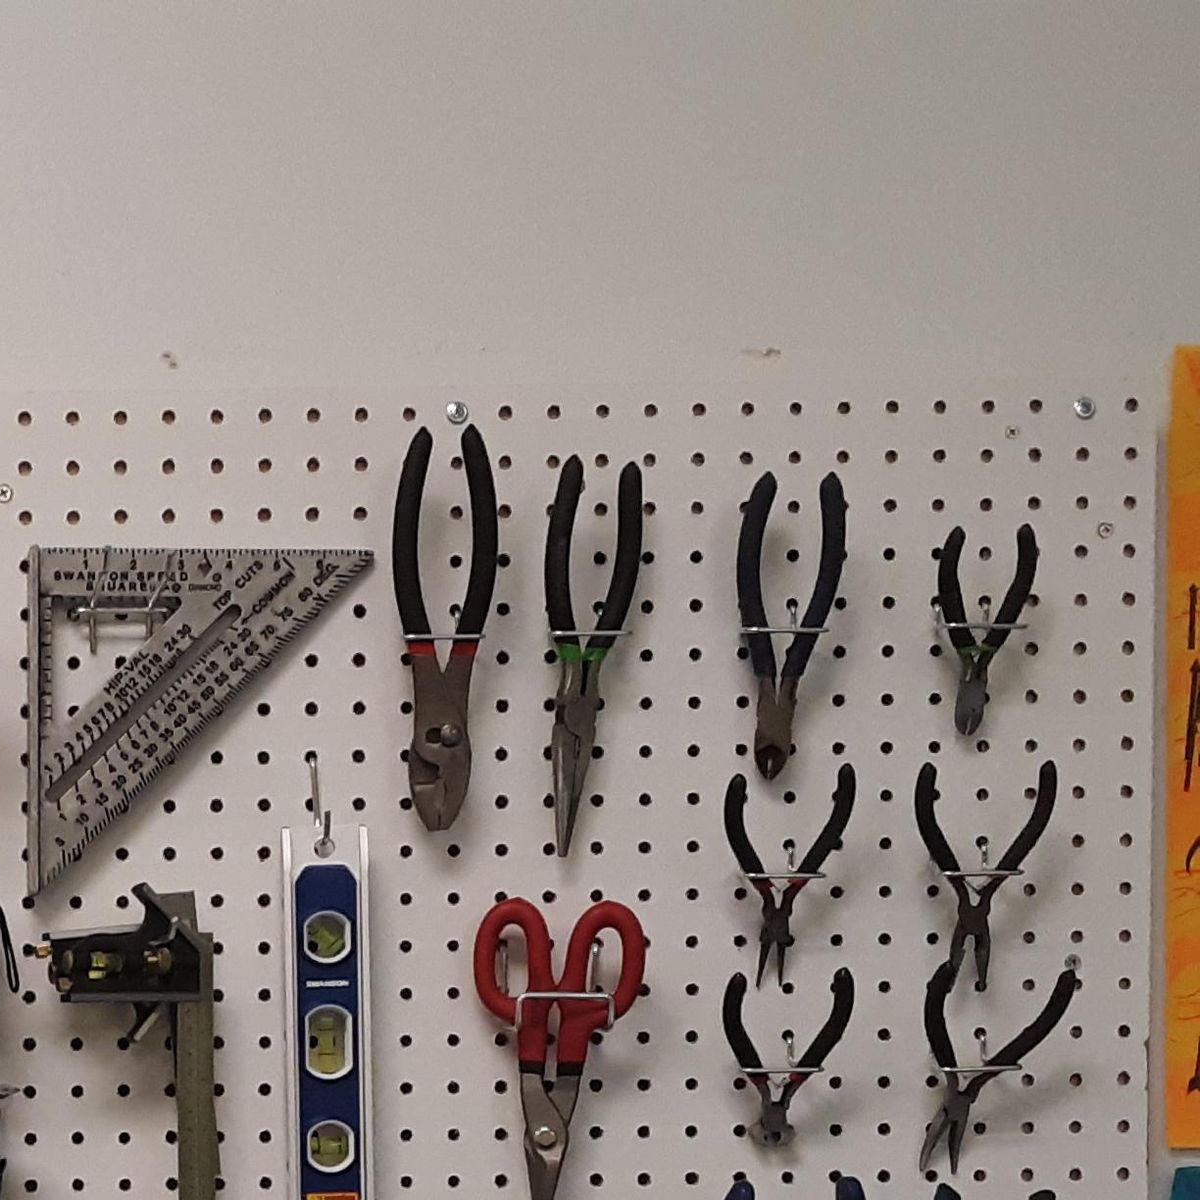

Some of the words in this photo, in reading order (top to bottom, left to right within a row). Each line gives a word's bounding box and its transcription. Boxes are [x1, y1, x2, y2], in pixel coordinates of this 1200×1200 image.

[54, 571, 130, 581] SWANON
[82, 559, 89, 571] 1
[129, 559, 138, 571] 2
[177, 559, 185, 571] 3
[225, 560, 233, 571] 4
[86, 582, 147, 591] SUARE
[212, 590, 232, 611] TOP
[234, 560, 264, 589] CUTS
[251, 570, 296, 615] COMMON
[97, 707, 107, 719] 7
[114, 686, 128, 700] 10
[125, 677, 139, 690] 12
[164, 636, 179, 652] 24
[176, 623, 192, 639] 30
[102, 651, 150, 696] HIP-VAL
[75, 812, 89, 826] 10
[95, 792, 109, 807] 15
[111, 774, 127, 790] 20
[128, 757, 144, 774] 25
[143, 742, 159, 758] 30
[158, 727, 175, 743] 35
[173, 713, 187, 728] 40
[187, 699, 202, 715] 45
[229, 656, 244, 672] 60
[244, 640, 260, 656] 65
[260, 624, 276, 641] 70
[278, 605, 293, 622] 75
[76, 793, 87, 806] 2
[108, 763, 117, 774] 4
[139, 728, 149, 740] 7
[163, 701, 177, 717] 10
[177, 689, 191, 703] 12
[192, 673, 206, 687] 15
[205, 660, 219, 674] 18
[223, 641, 238, 657] 24
[237, 627, 252, 642] 30
